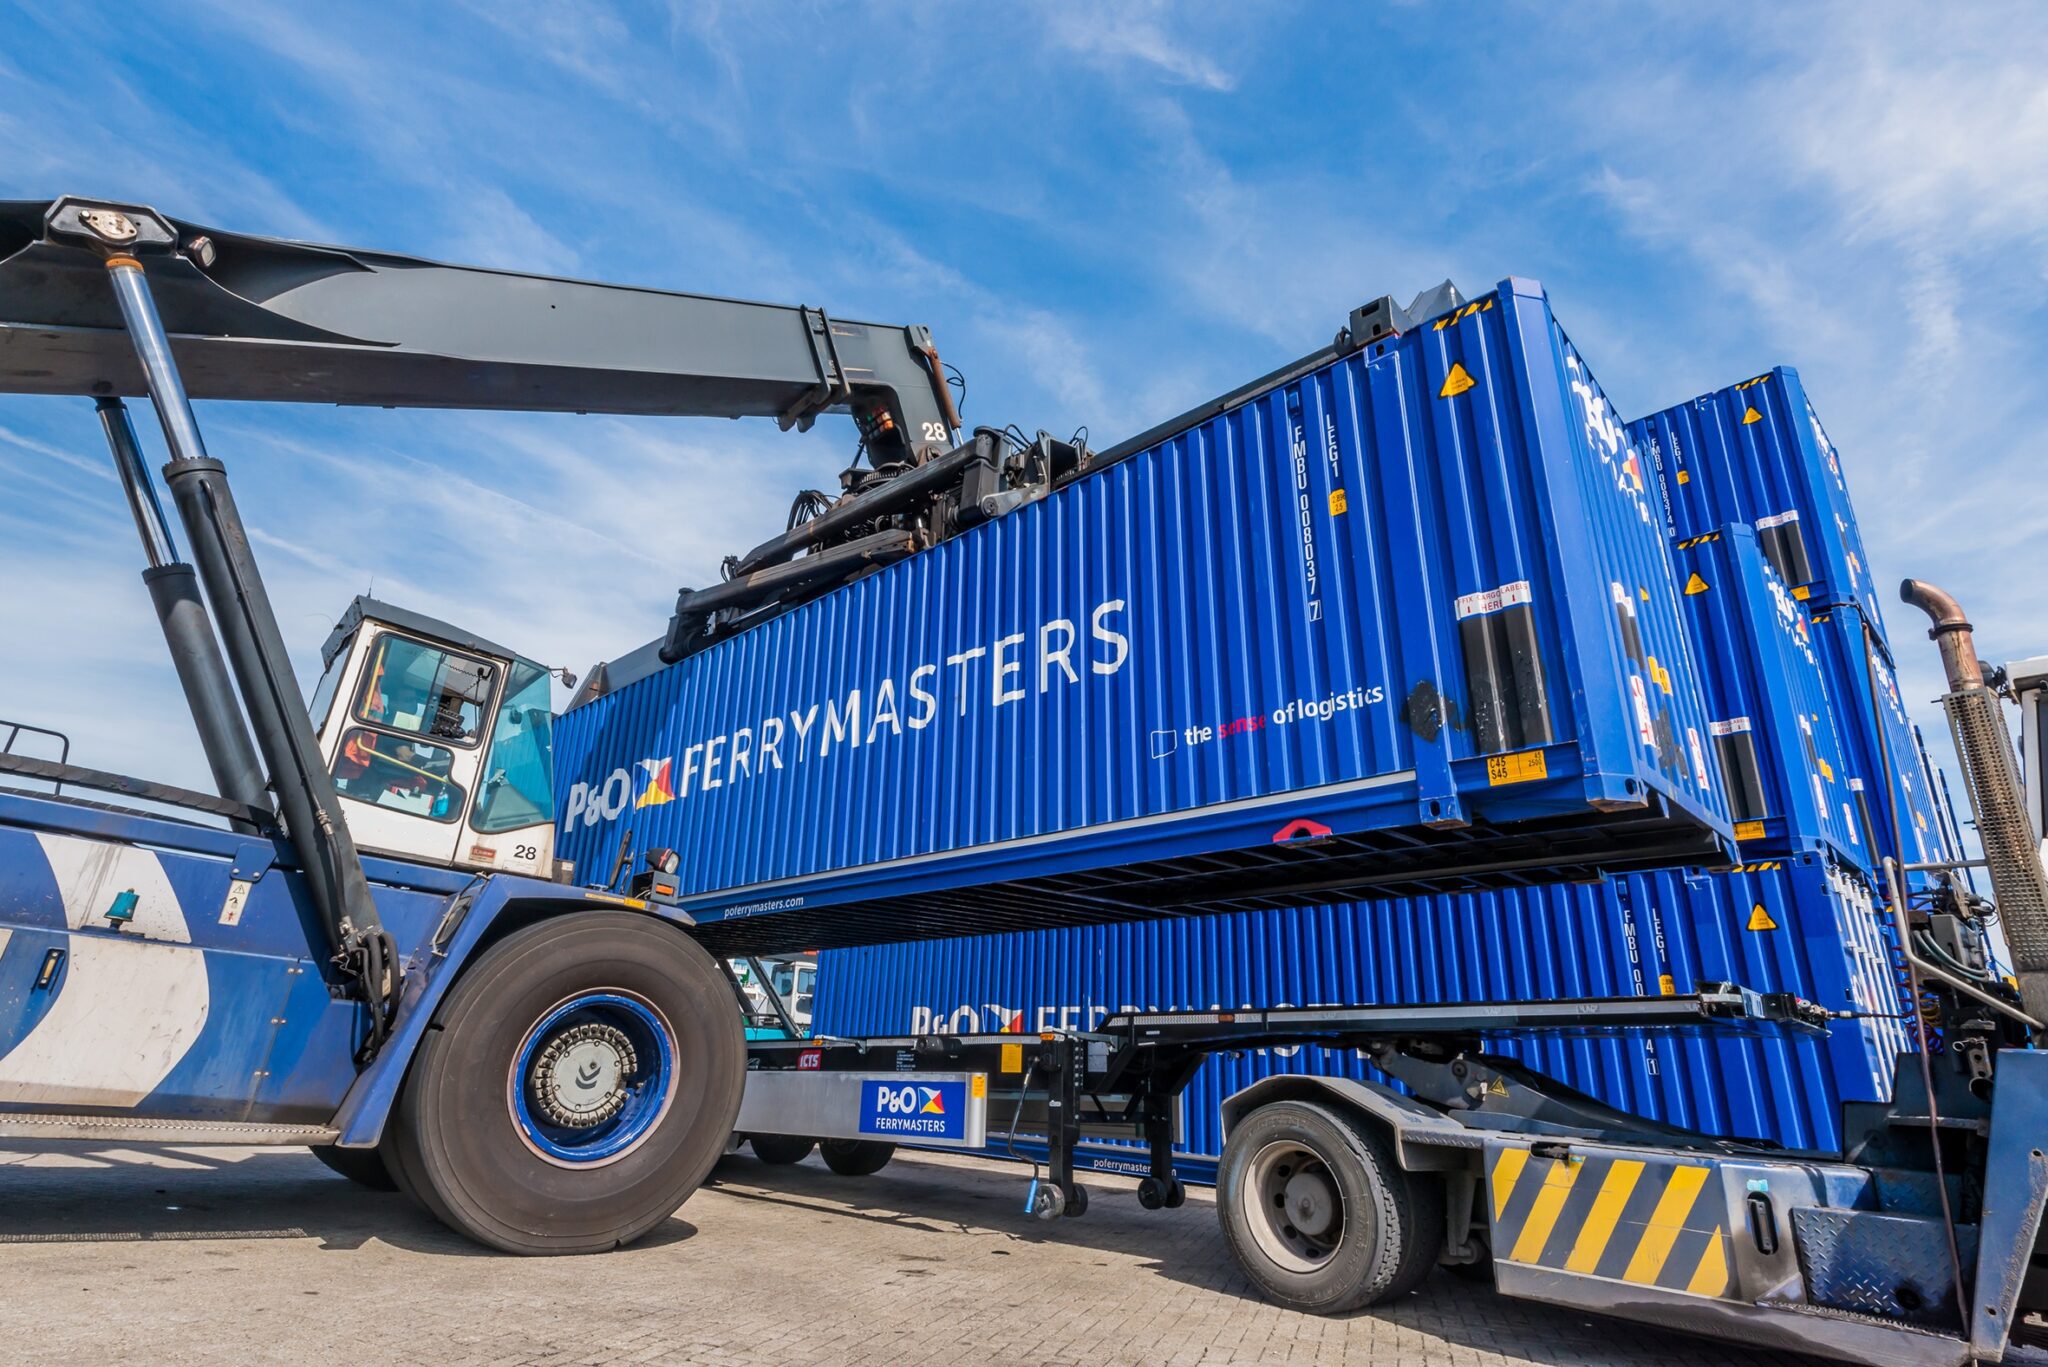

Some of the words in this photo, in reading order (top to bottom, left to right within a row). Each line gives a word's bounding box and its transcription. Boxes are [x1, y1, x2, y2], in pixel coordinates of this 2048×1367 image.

[922, 421, 947, 441] 28
[1326, 413, 1339, 478] LEG1
[1293, 425, 1307, 490] FMBU
[1300, 493, 1316, 595] 008037
[1309, 601, 1320, 620] 7
[564, 768, 631, 833] P&O
[680, 599, 1129, 798] FERRYMASTERS
[1184, 725, 1212, 746] the
[1218, 714, 1267, 740] sense
[1272, 702, 1295, 725] of
[1297, 686, 1384, 721] logistics
[1489, 757, 1506, 769] C45
[1491, 768, 1508, 780] S45
[513, 844, 537, 860] 28
[724, 896, 804, 920] poferrymasters.com
[1624, 910, 1639, 964] FMBU
[1652, 908, 1665, 962] LEG1
[800, 1054, 820, 1068] ICTS
[877, 1086, 917, 1114] P&O
[875, 1117, 945, 1133] FERRYMASTERS
